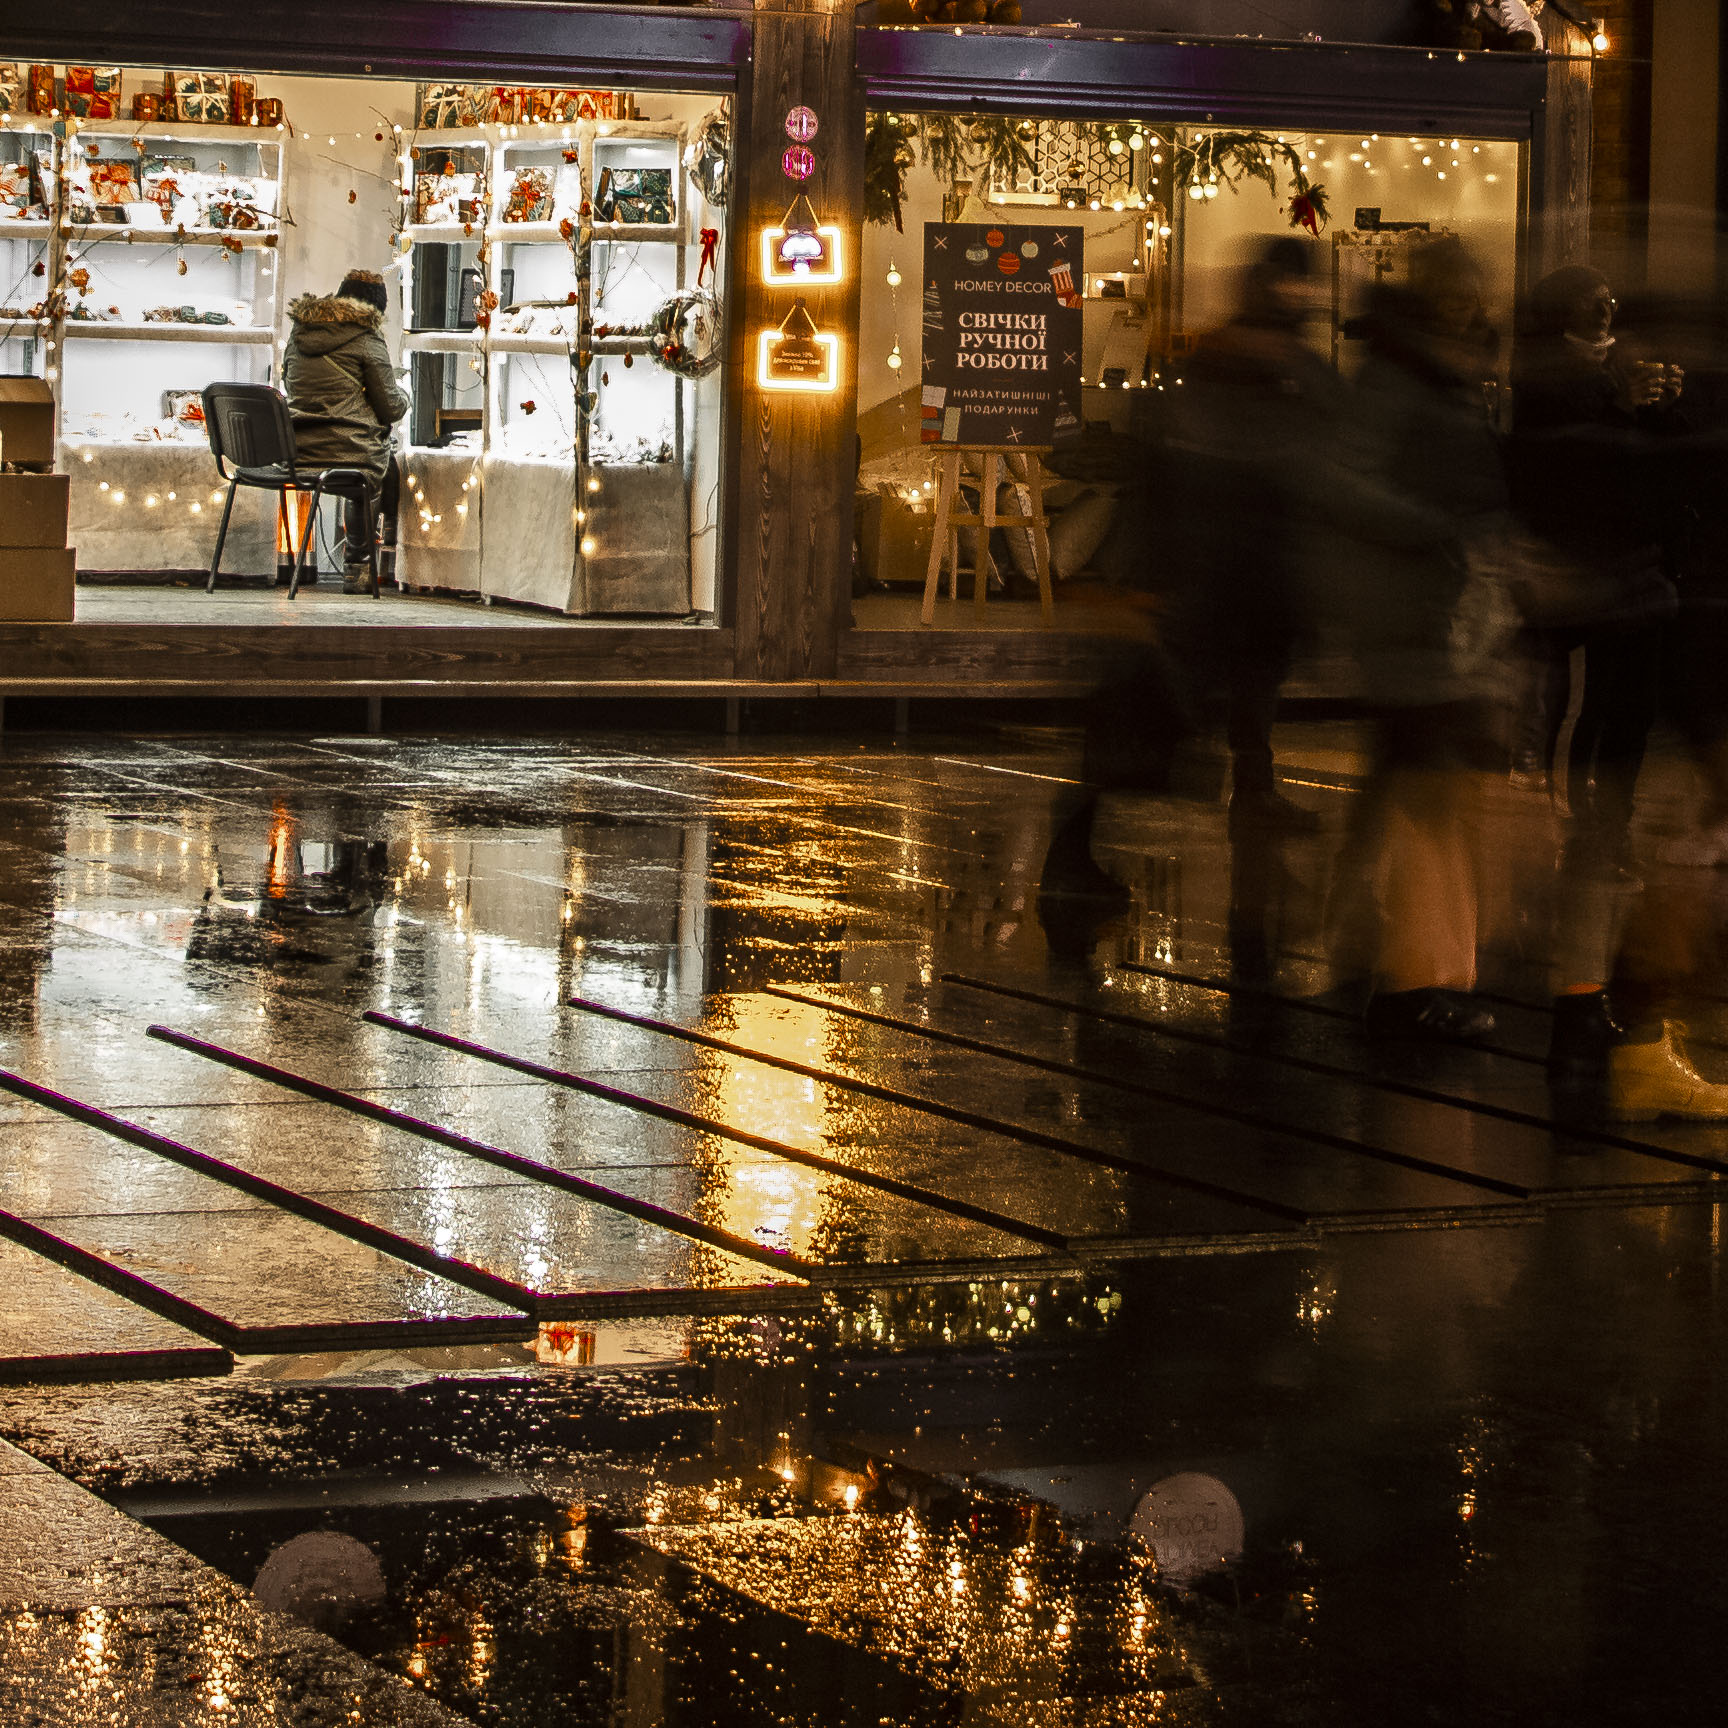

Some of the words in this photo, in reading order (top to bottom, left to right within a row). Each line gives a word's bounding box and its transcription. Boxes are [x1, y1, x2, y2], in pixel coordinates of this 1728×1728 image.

[954, 280, 1003, 292] HOMEY
[1005, 281, 1052, 293] DECOR
[958, 312, 1047, 330] СВІЧКИ
[959, 331, 1047, 350] РУЧНОЇ
[956, 352, 1048, 370] РОБОТИ
[953, 388, 1050, 401] НАЙЗАТИШНІШІ
[964, 405, 1039, 415] ПОДАРУНКИ
